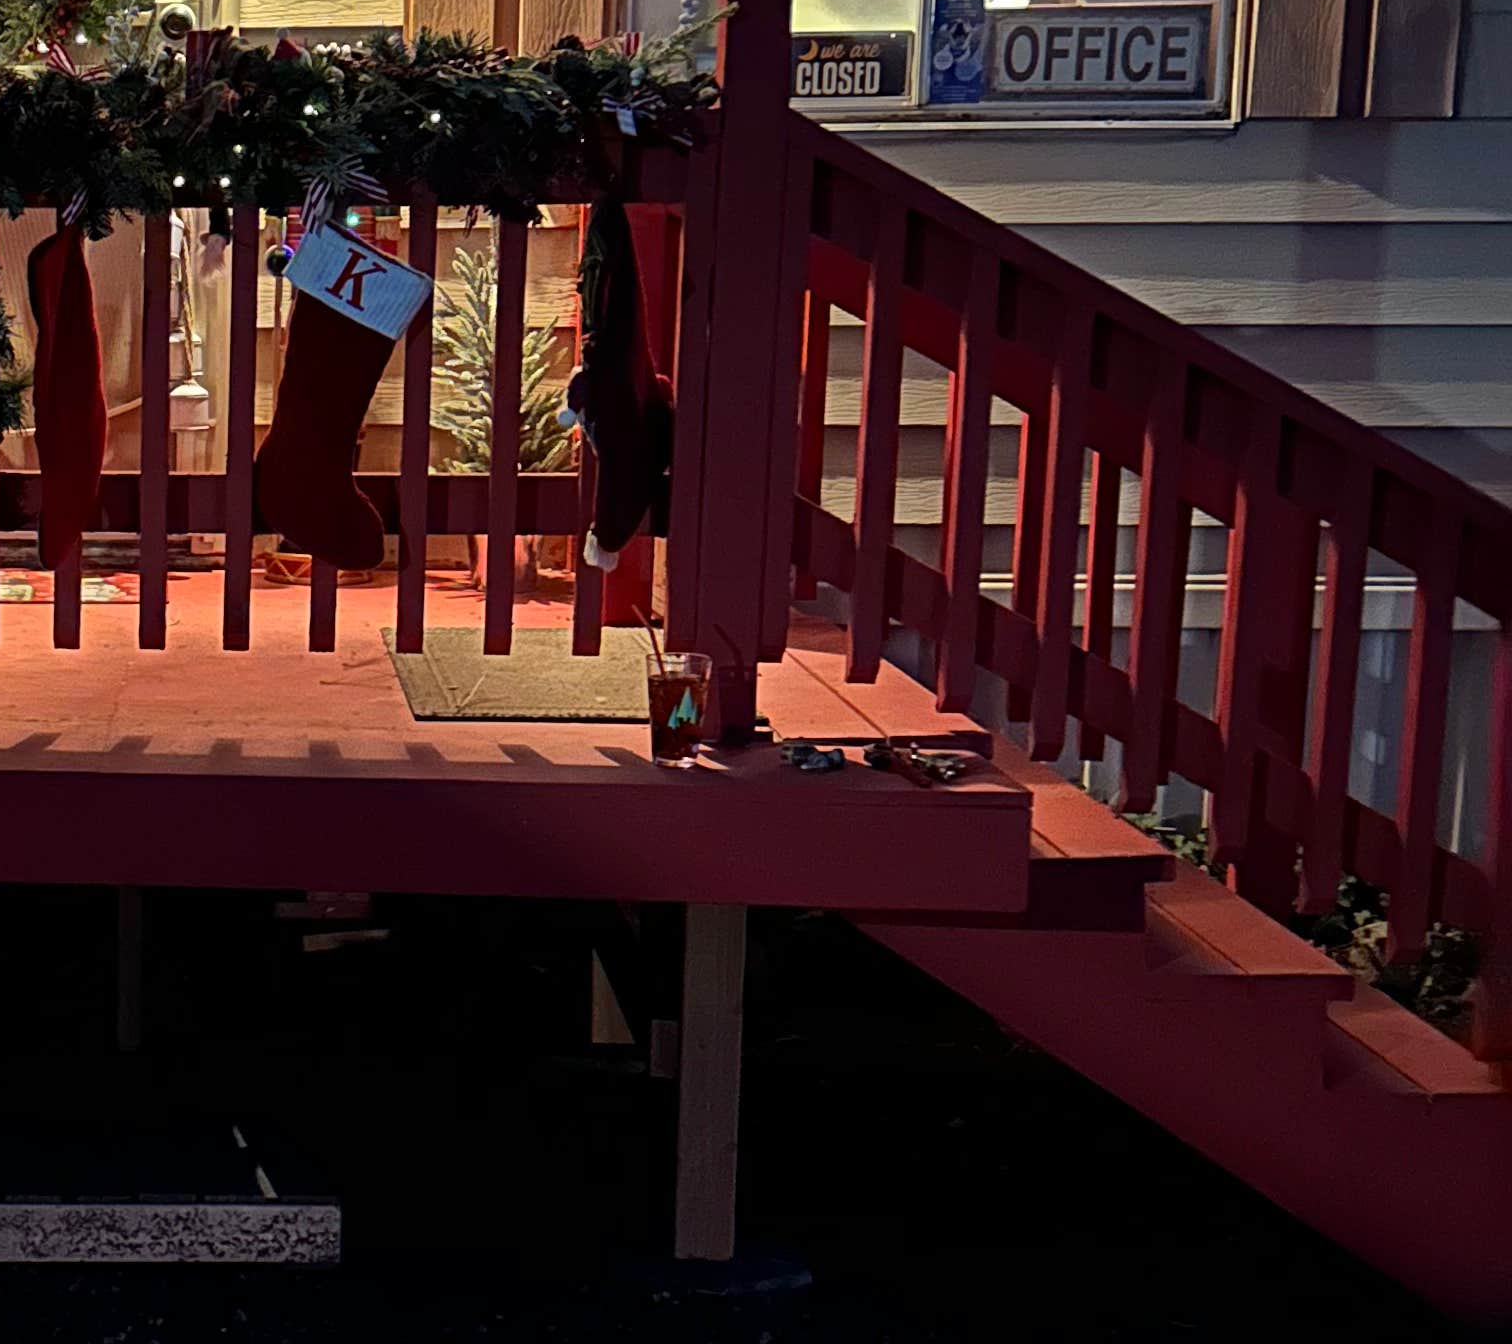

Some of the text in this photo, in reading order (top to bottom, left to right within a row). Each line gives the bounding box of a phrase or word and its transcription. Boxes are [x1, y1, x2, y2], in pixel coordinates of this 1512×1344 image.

[819, 41, 881, 59] we are
[1003, 25, 1190, 83] OFFICE
[795, 60, 881, 96] CLOSED
[324, 247, 388, 312] K
